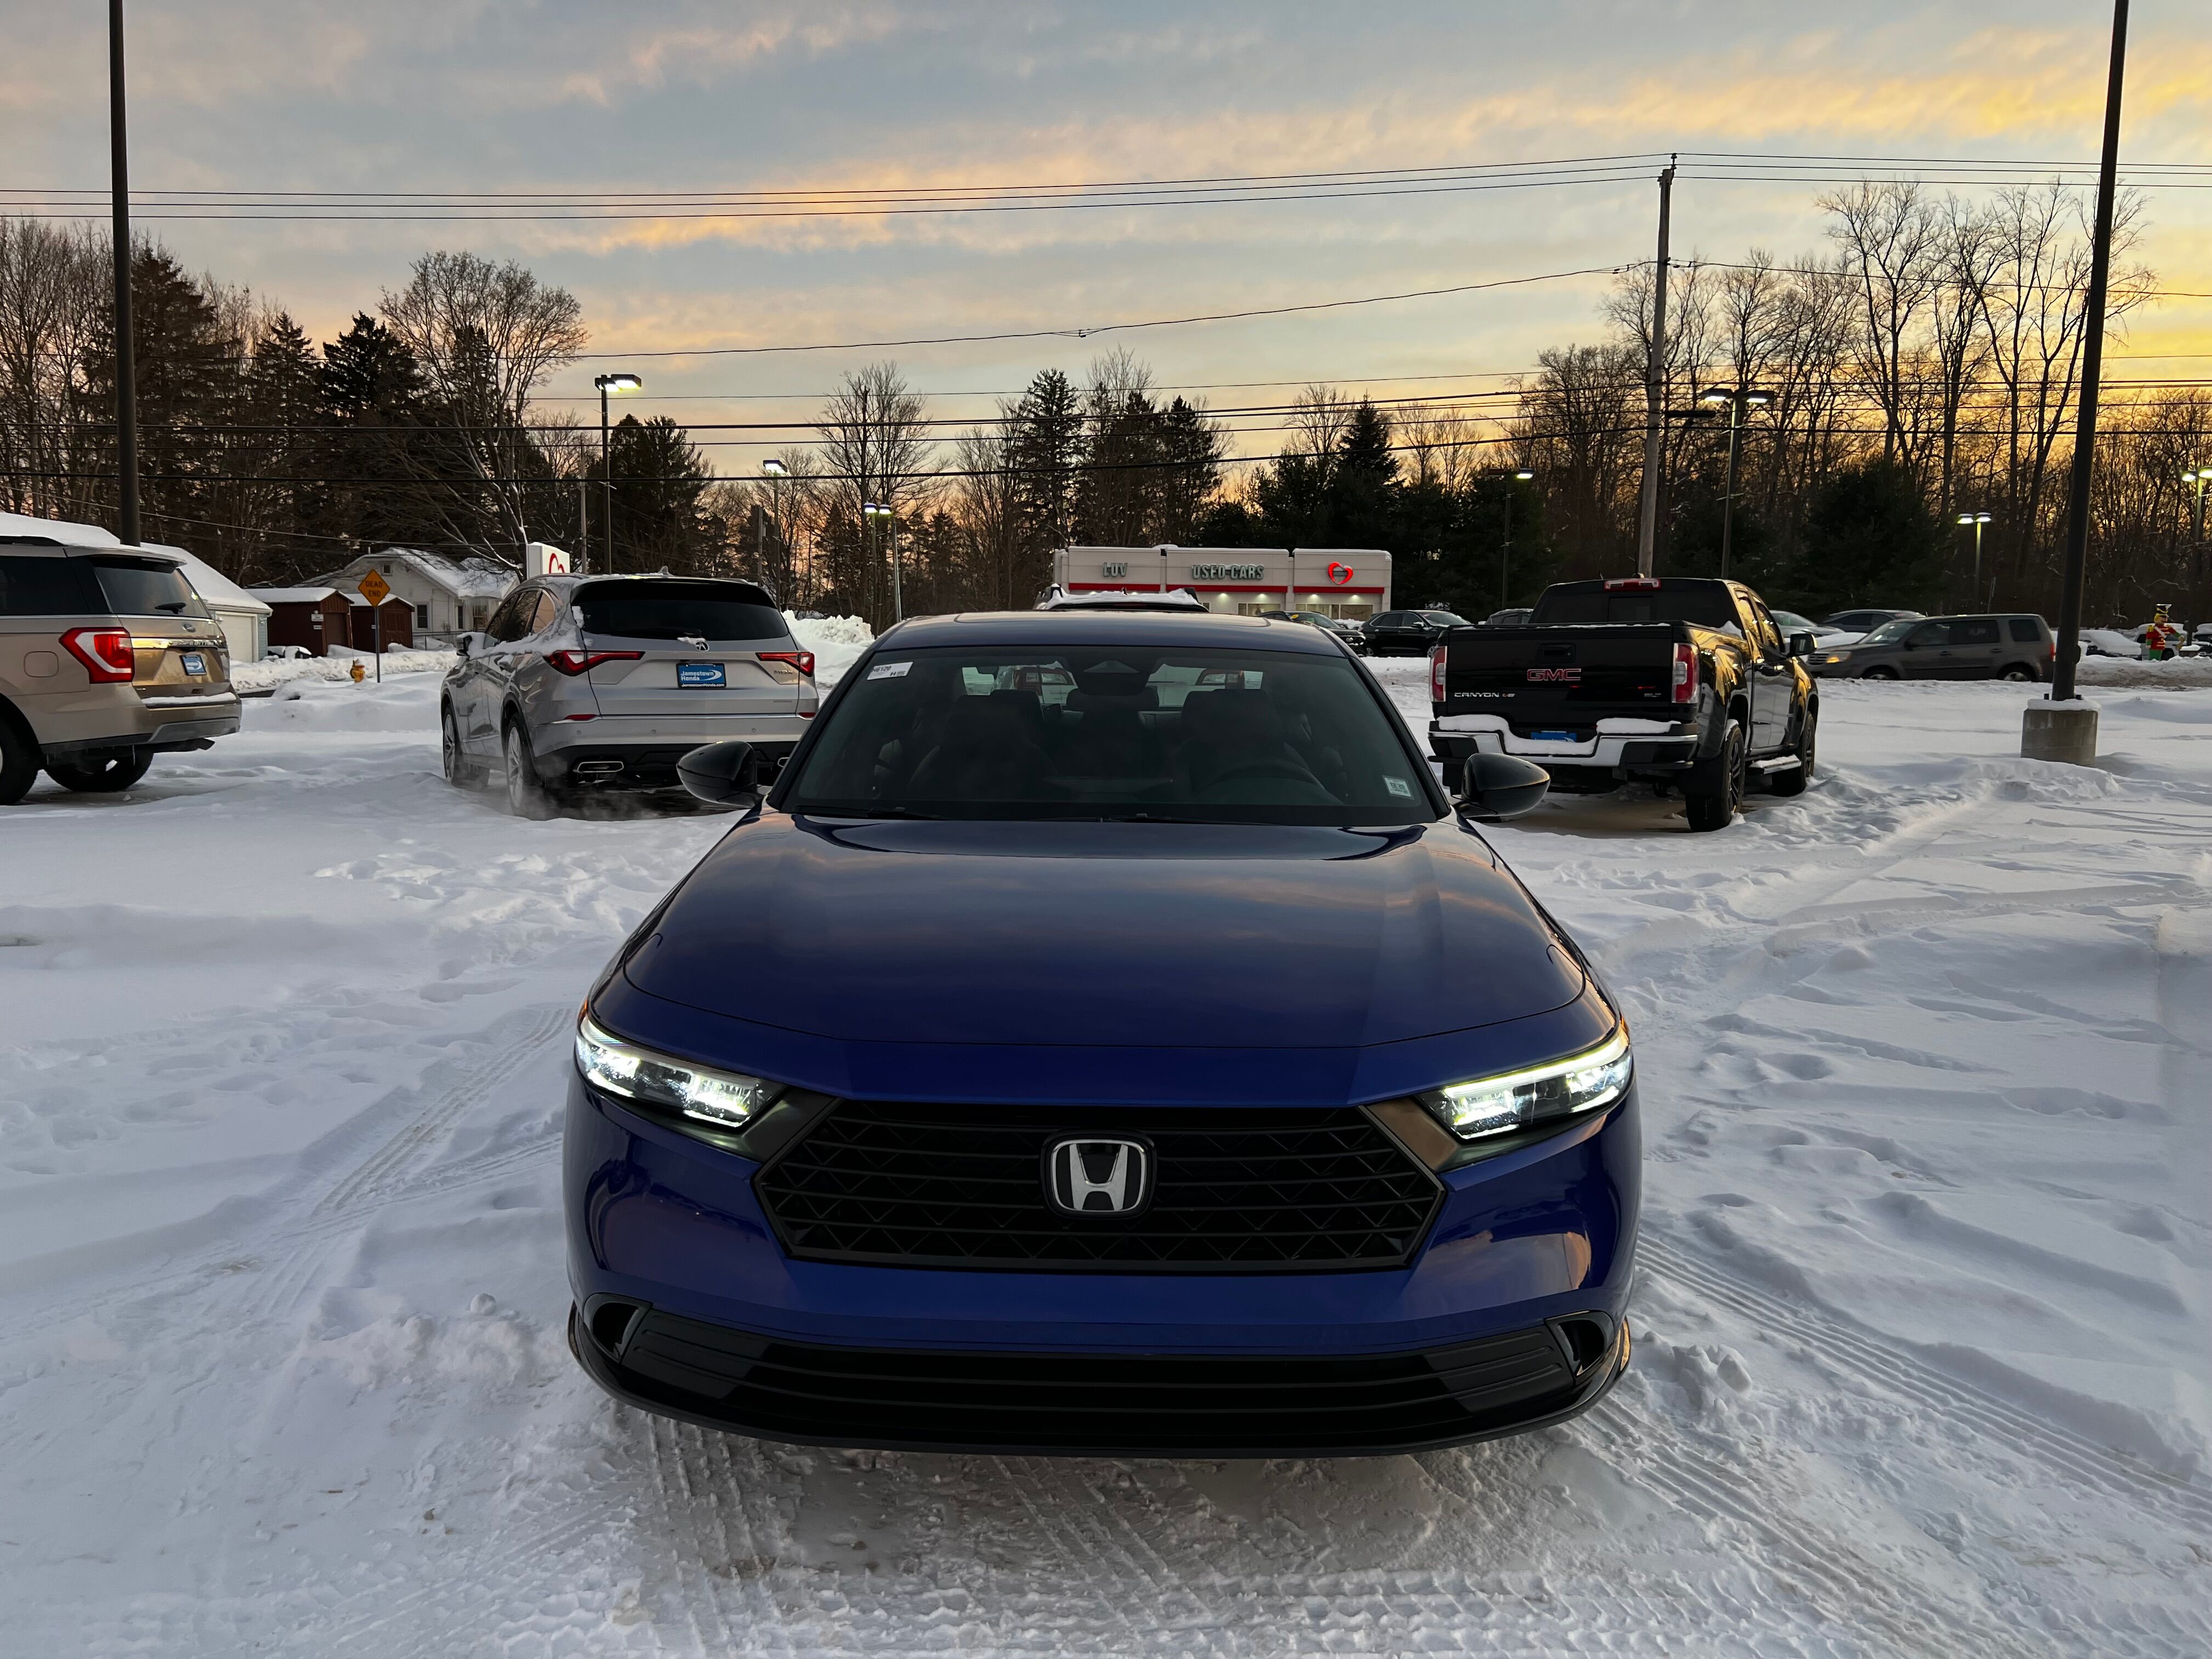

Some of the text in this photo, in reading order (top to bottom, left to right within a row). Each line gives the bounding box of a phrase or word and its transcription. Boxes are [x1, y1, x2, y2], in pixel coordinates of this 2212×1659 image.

[1103, 562, 1128, 577] LUV
[1193, 564, 1264, 580] USED CARS
[1527, 668, 1581, 681] GMC
